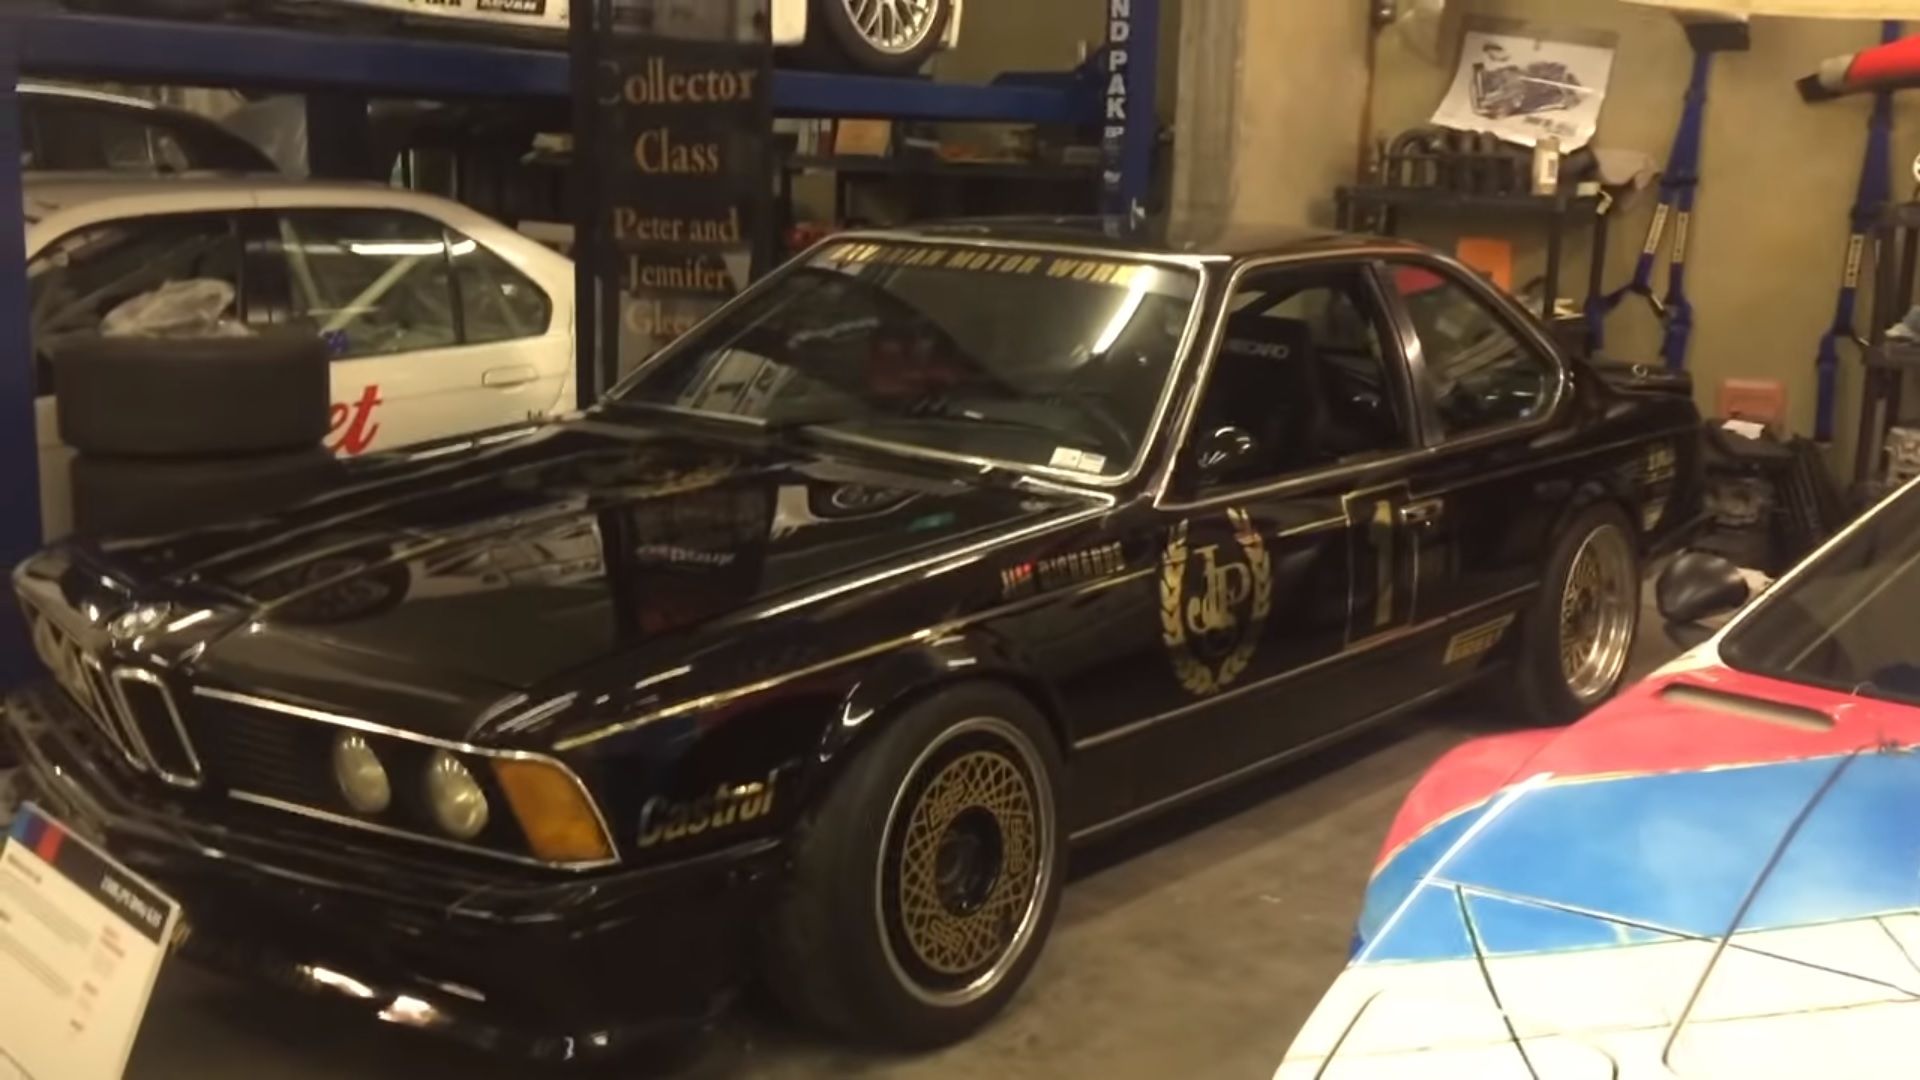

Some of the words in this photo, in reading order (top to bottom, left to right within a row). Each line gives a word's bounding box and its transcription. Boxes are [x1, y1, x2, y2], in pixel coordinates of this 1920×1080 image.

[598, 56, 757, 104] Collector
[634, 127, 719, 173] Class
[613, 206, 683, 241] Peter
[689, 205, 740, 242] and
[622, 253, 726, 291] Jennifer
[946, 251, 1042, 275] MOTOR
[637, 767, 780, 847] Castrol
